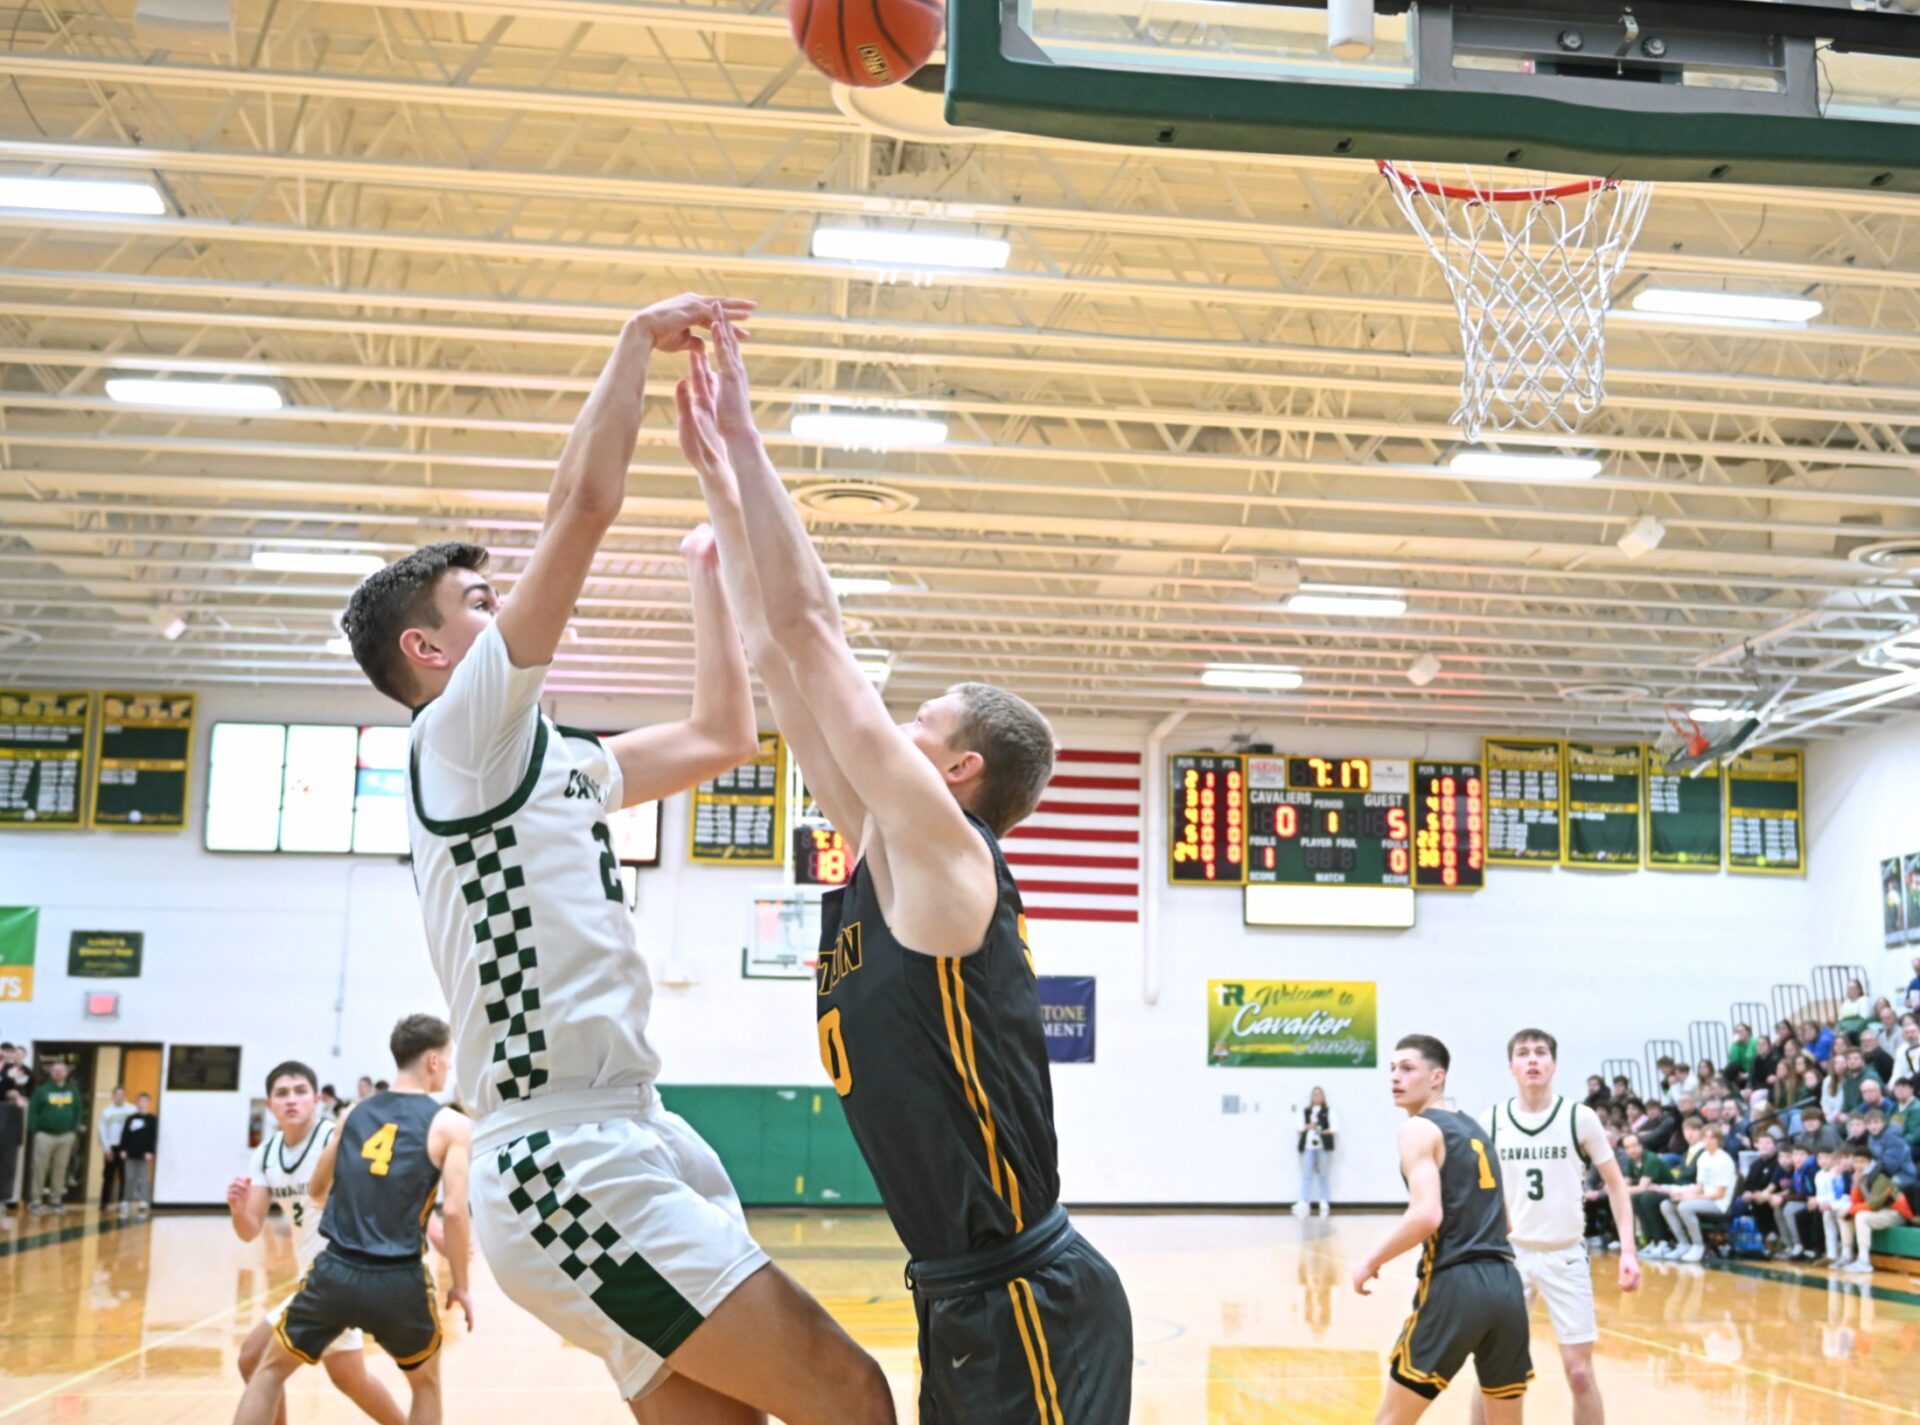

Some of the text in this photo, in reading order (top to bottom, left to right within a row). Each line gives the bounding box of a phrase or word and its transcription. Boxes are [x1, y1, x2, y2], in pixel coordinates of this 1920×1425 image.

[1205, 771, 1215, 788] 1
[1227, 770, 1241, 789] 0
[1308, 757, 1369, 788] 7:17
[1431, 778, 1440, 795] 1
[1441, 777, 1456, 796] 0
[1466, 777, 1480, 796] 0
[1200, 788, 1215, 807] 0
[1227, 789, 1241, 808] 0
[1250, 790, 1313, 805] CAVALIERS
[1364, 793, 1404, 807] GUEST
[1441, 796, 1456, 814] 0
[1467, 795, 1481, 814] 0
[1200, 807, 1215, 825] 0
[1227, 808, 1241, 826] 0
[1274, 805, 1297, 838] 0
[1327, 810, 1339, 834] 1
[1387, 807, 1409, 840] 5
[1442, 813, 1456, 832] 0
[1467, 813, 1481, 832] 0
[1200, 824, 1215, 843] 0
[1227, 825, 1241, 844] 0
[1300, 837, 1358, 848] PLAYER FOUL
[1381, 839, 1408, 849] FOULS
[1442, 831, 1456, 850] 0
[1200, 842, 1215, 862] 0
[1227, 843, 1241, 864] 0
[1263, 846, 1275, 869] 1
[1389, 847, 1408, 875] 0
[1442, 849, 1457, 868] 0
[816, 849, 846, 883] 18
[1254, 983, 1354, 1008] Welcome to
[1231, 1001, 1353, 1037] Cavalier
[360, 1122, 399, 1177] 4
[1500, 1146, 1568, 1160] CAVALIERS
[1470, 1138, 1497, 1190] 1
[1525, 1168, 1545, 1201] 3
